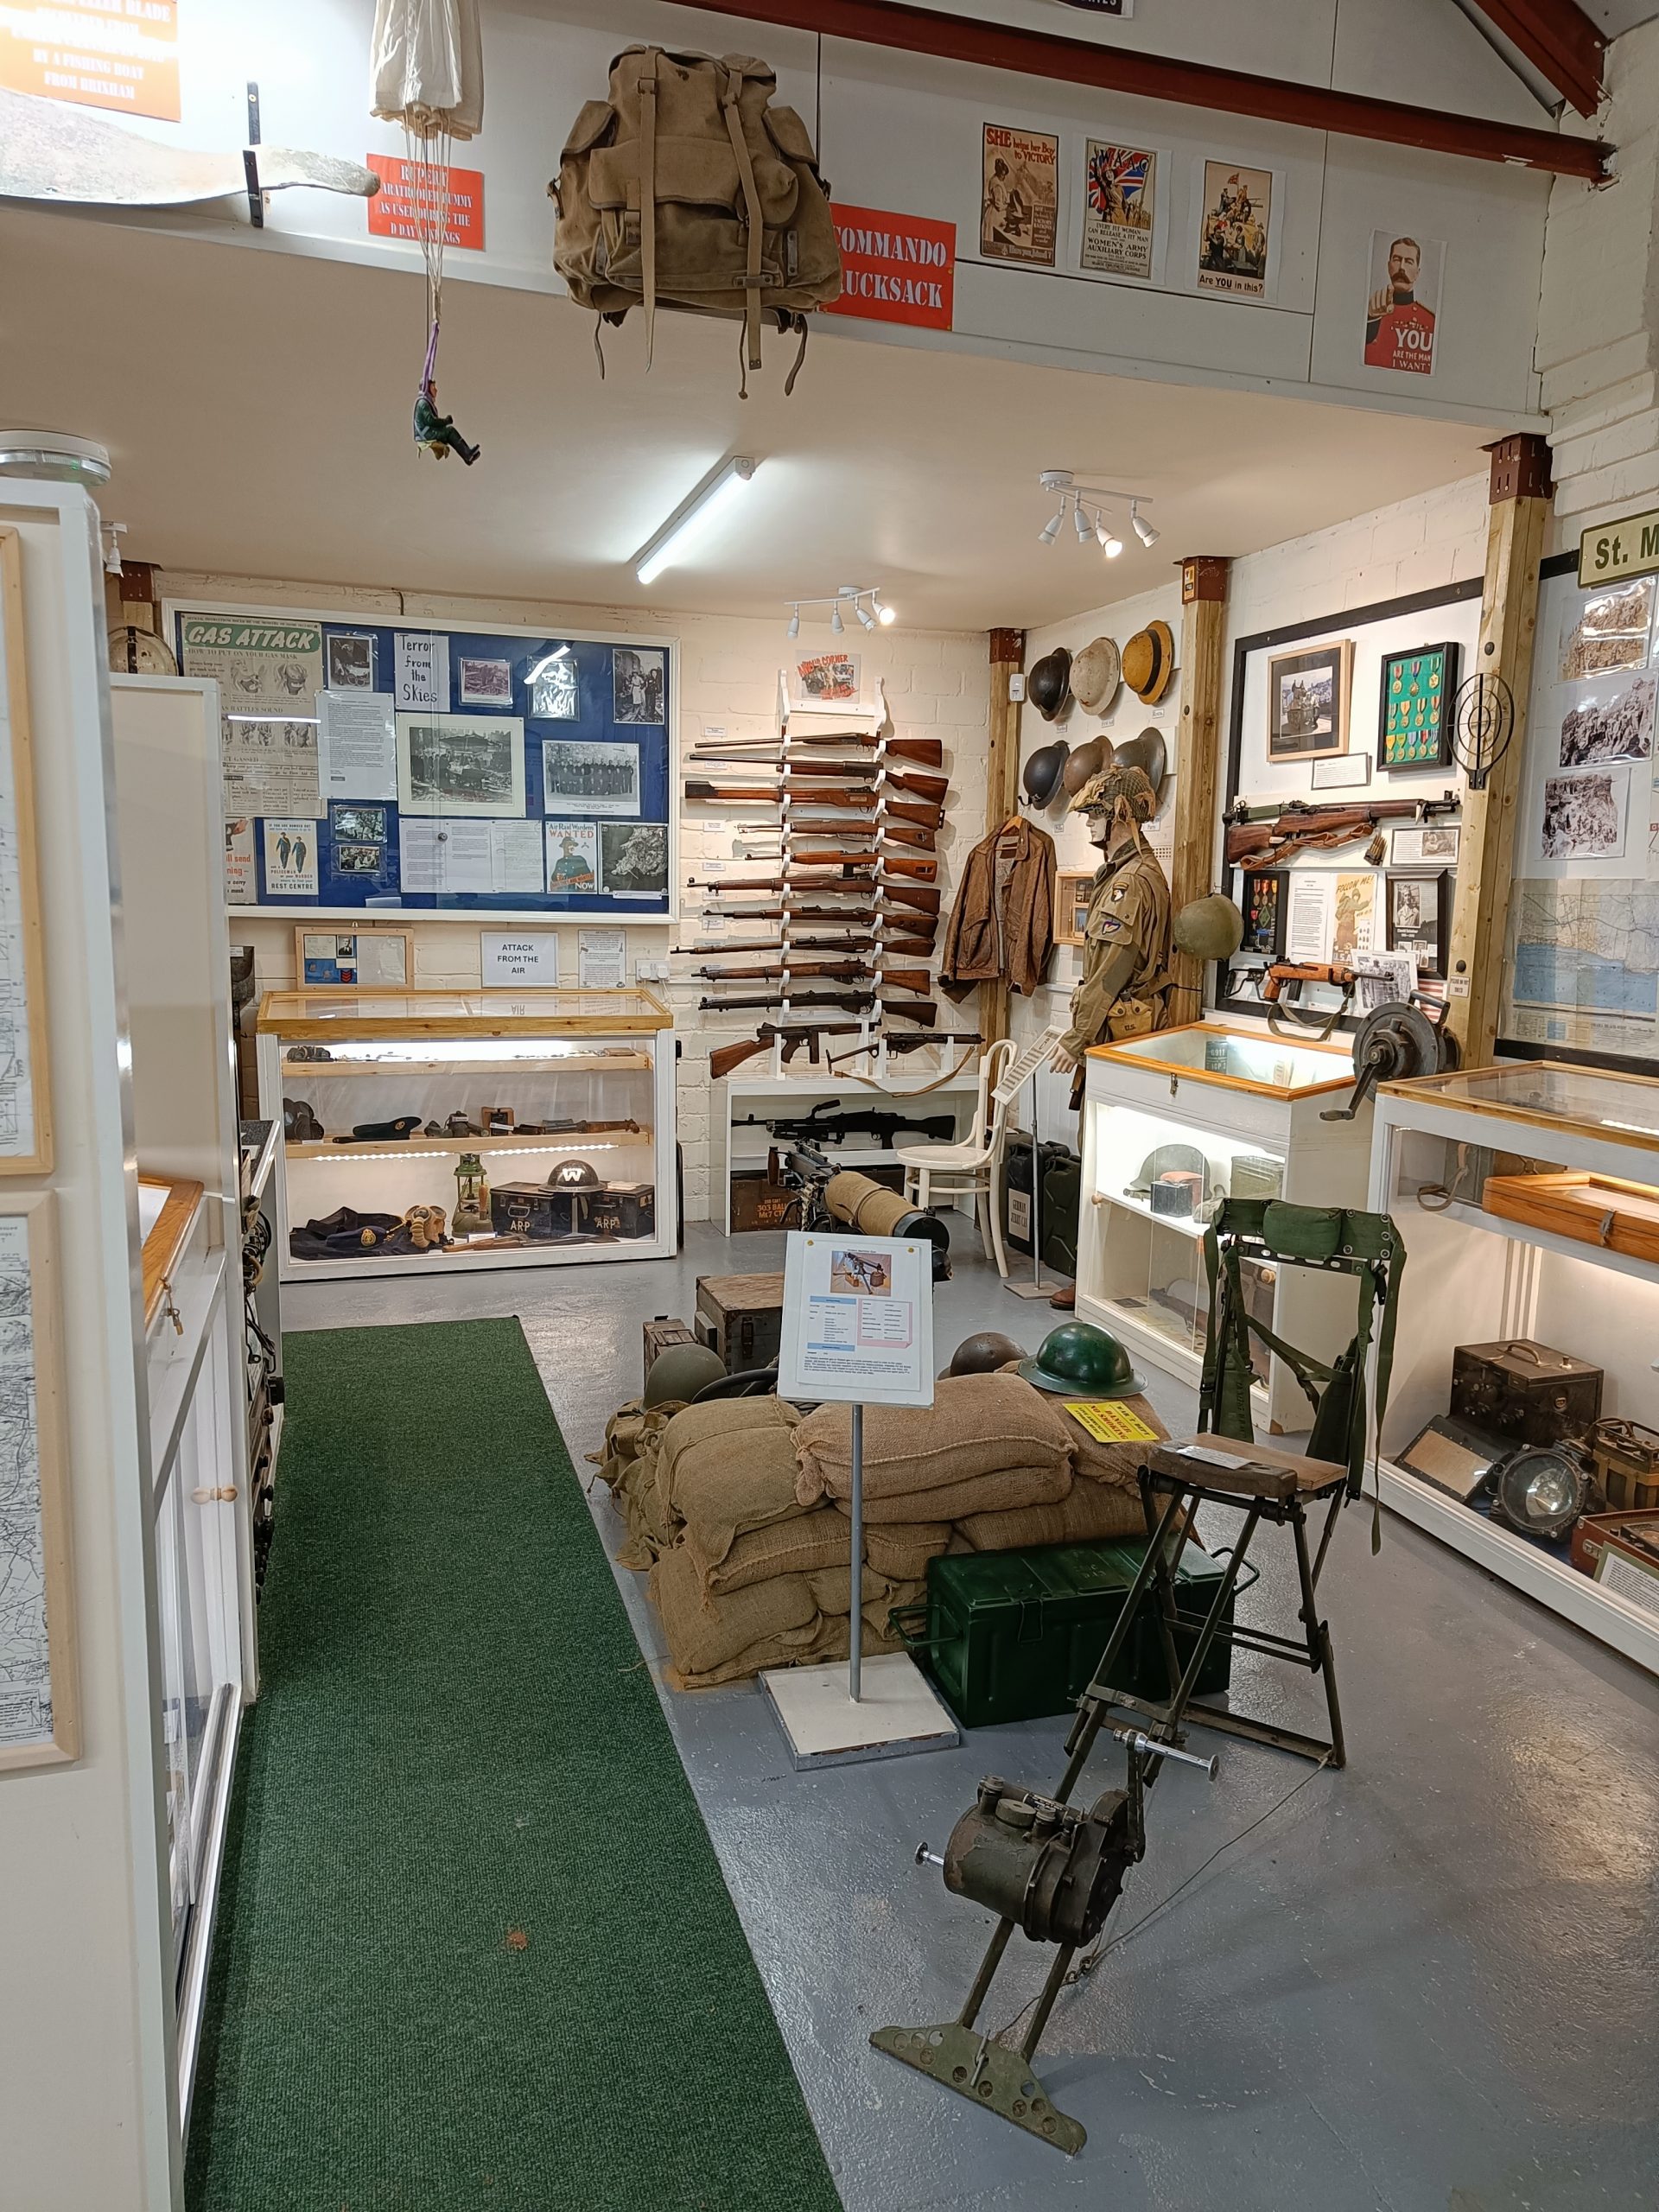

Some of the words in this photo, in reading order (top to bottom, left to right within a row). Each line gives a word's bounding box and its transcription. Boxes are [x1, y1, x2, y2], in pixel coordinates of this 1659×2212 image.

[126, 0, 170, 22] BLADE
[33, 48, 48, 64] BY
[53, 52, 62, 66] A
[62, 53, 111, 74] FISHING
[114, 61, 144, 80] BOAT
[44, 71, 77, 89] FROM
[79, 77, 136, 99] BRIXHAM
[986, 128, 1012, 148] SHE
[1013, 137, 1029, 152] helps
[1031, 140, 1041, 151] her
[1042, 142, 1055, 155] Boy
[1014, 149, 1022, 160] to
[1023, 151, 1056, 165] VICTORY
[380, 201, 391, 215] AS
[453, 213, 471, 227] THE
[391, 222, 397, 235] D
[399, 223, 416, 238] DAY
[1088, 237, 1123, 249] WOMEN'S
[1126, 245, 1147, 253] ARMY
[1088, 245, 1123, 255] AUXILIARY
[1125, 251, 1147, 259] CORPS
[839, 270, 943, 308] UCKSACK
[1199, 274, 1213, 284] Are
[1216, 276, 1232, 288] YOU
[1235, 280, 1243, 289] in
[1244, 281, 1263, 293] this?
[1395, 327, 1433, 352] YOU
[1393, 350, 1404, 359] ARE
[1405, 351, 1417, 360] THE
[1419, 353, 1431, 362] MAN
[1392, 359, 1395, 367] I
[1400, 359, 1427, 372] WANT
[1595, 536, 1629, 569] St.
[188, 626, 232, 645] GAS
[235, 628, 315, 650] ATTACK
[399, 634, 435, 652] Terror
[404, 655, 431, 669] from
[411, 669, 426, 682] the
[403, 683, 437, 702] Skies
[550, 830, 594, 838] WANTED
[234, 855, 251, 863] send
[226, 867, 243, 876] ning
[575, 882, 594, 893] NOW
[1336, 880, 1360, 894] FOLLOW
[1361, 874, 1375, 887] ME!
[562, 1167, 585, 1182] W
[1116, 1406, 1130, 1417] WAR
[1090, 1405, 1101, 1414] NO
[1098, 1414, 1128, 1440] SMOKING
[1105, 1410, 1132, 1433] DANGER
